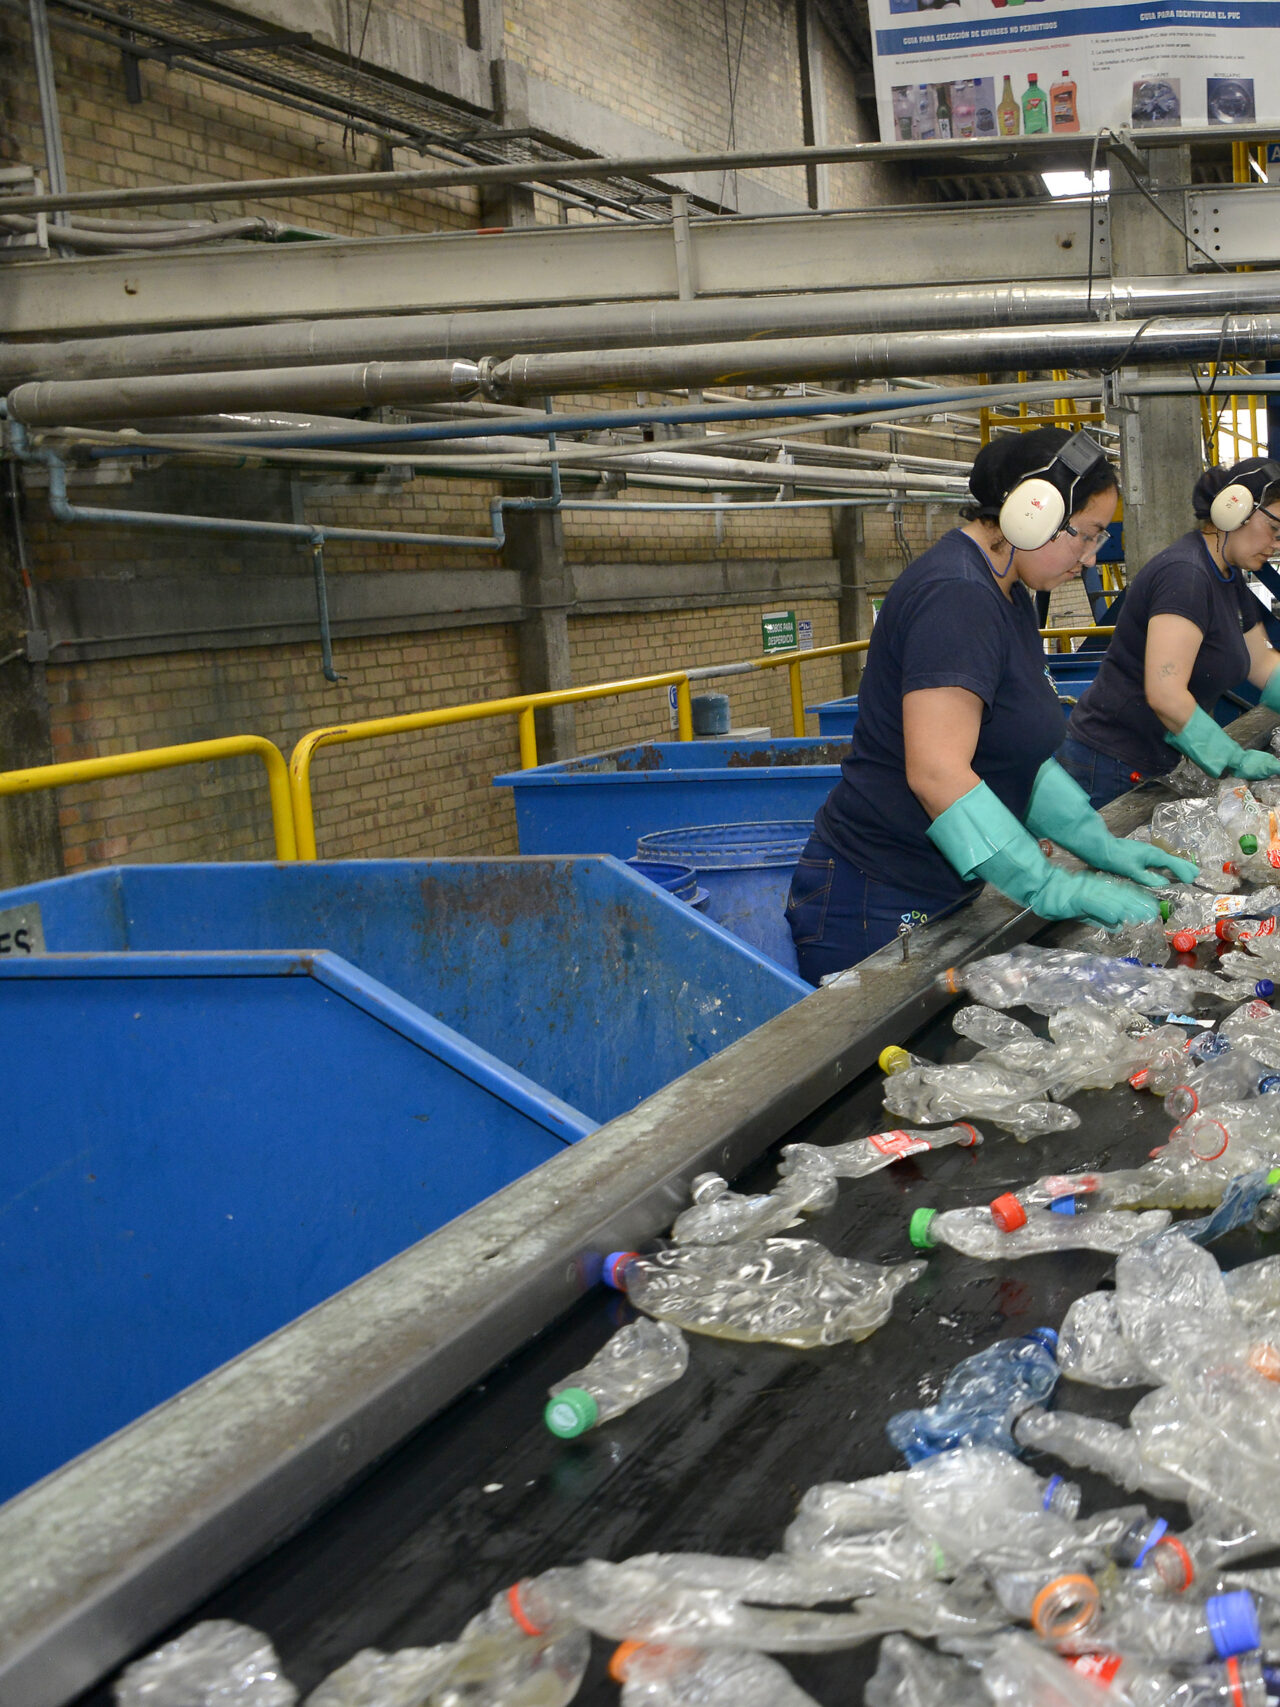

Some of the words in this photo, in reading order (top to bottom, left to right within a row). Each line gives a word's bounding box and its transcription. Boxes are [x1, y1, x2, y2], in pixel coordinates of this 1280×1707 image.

[1157, 10, 1174, 18] PARA
[919, 34, 935, 43] PARA
[970, 30, 980, 38] DE
[981, 27, 1009, 37] ENVASES
[1020, 22, 1057, 32] PERMITIDOS
